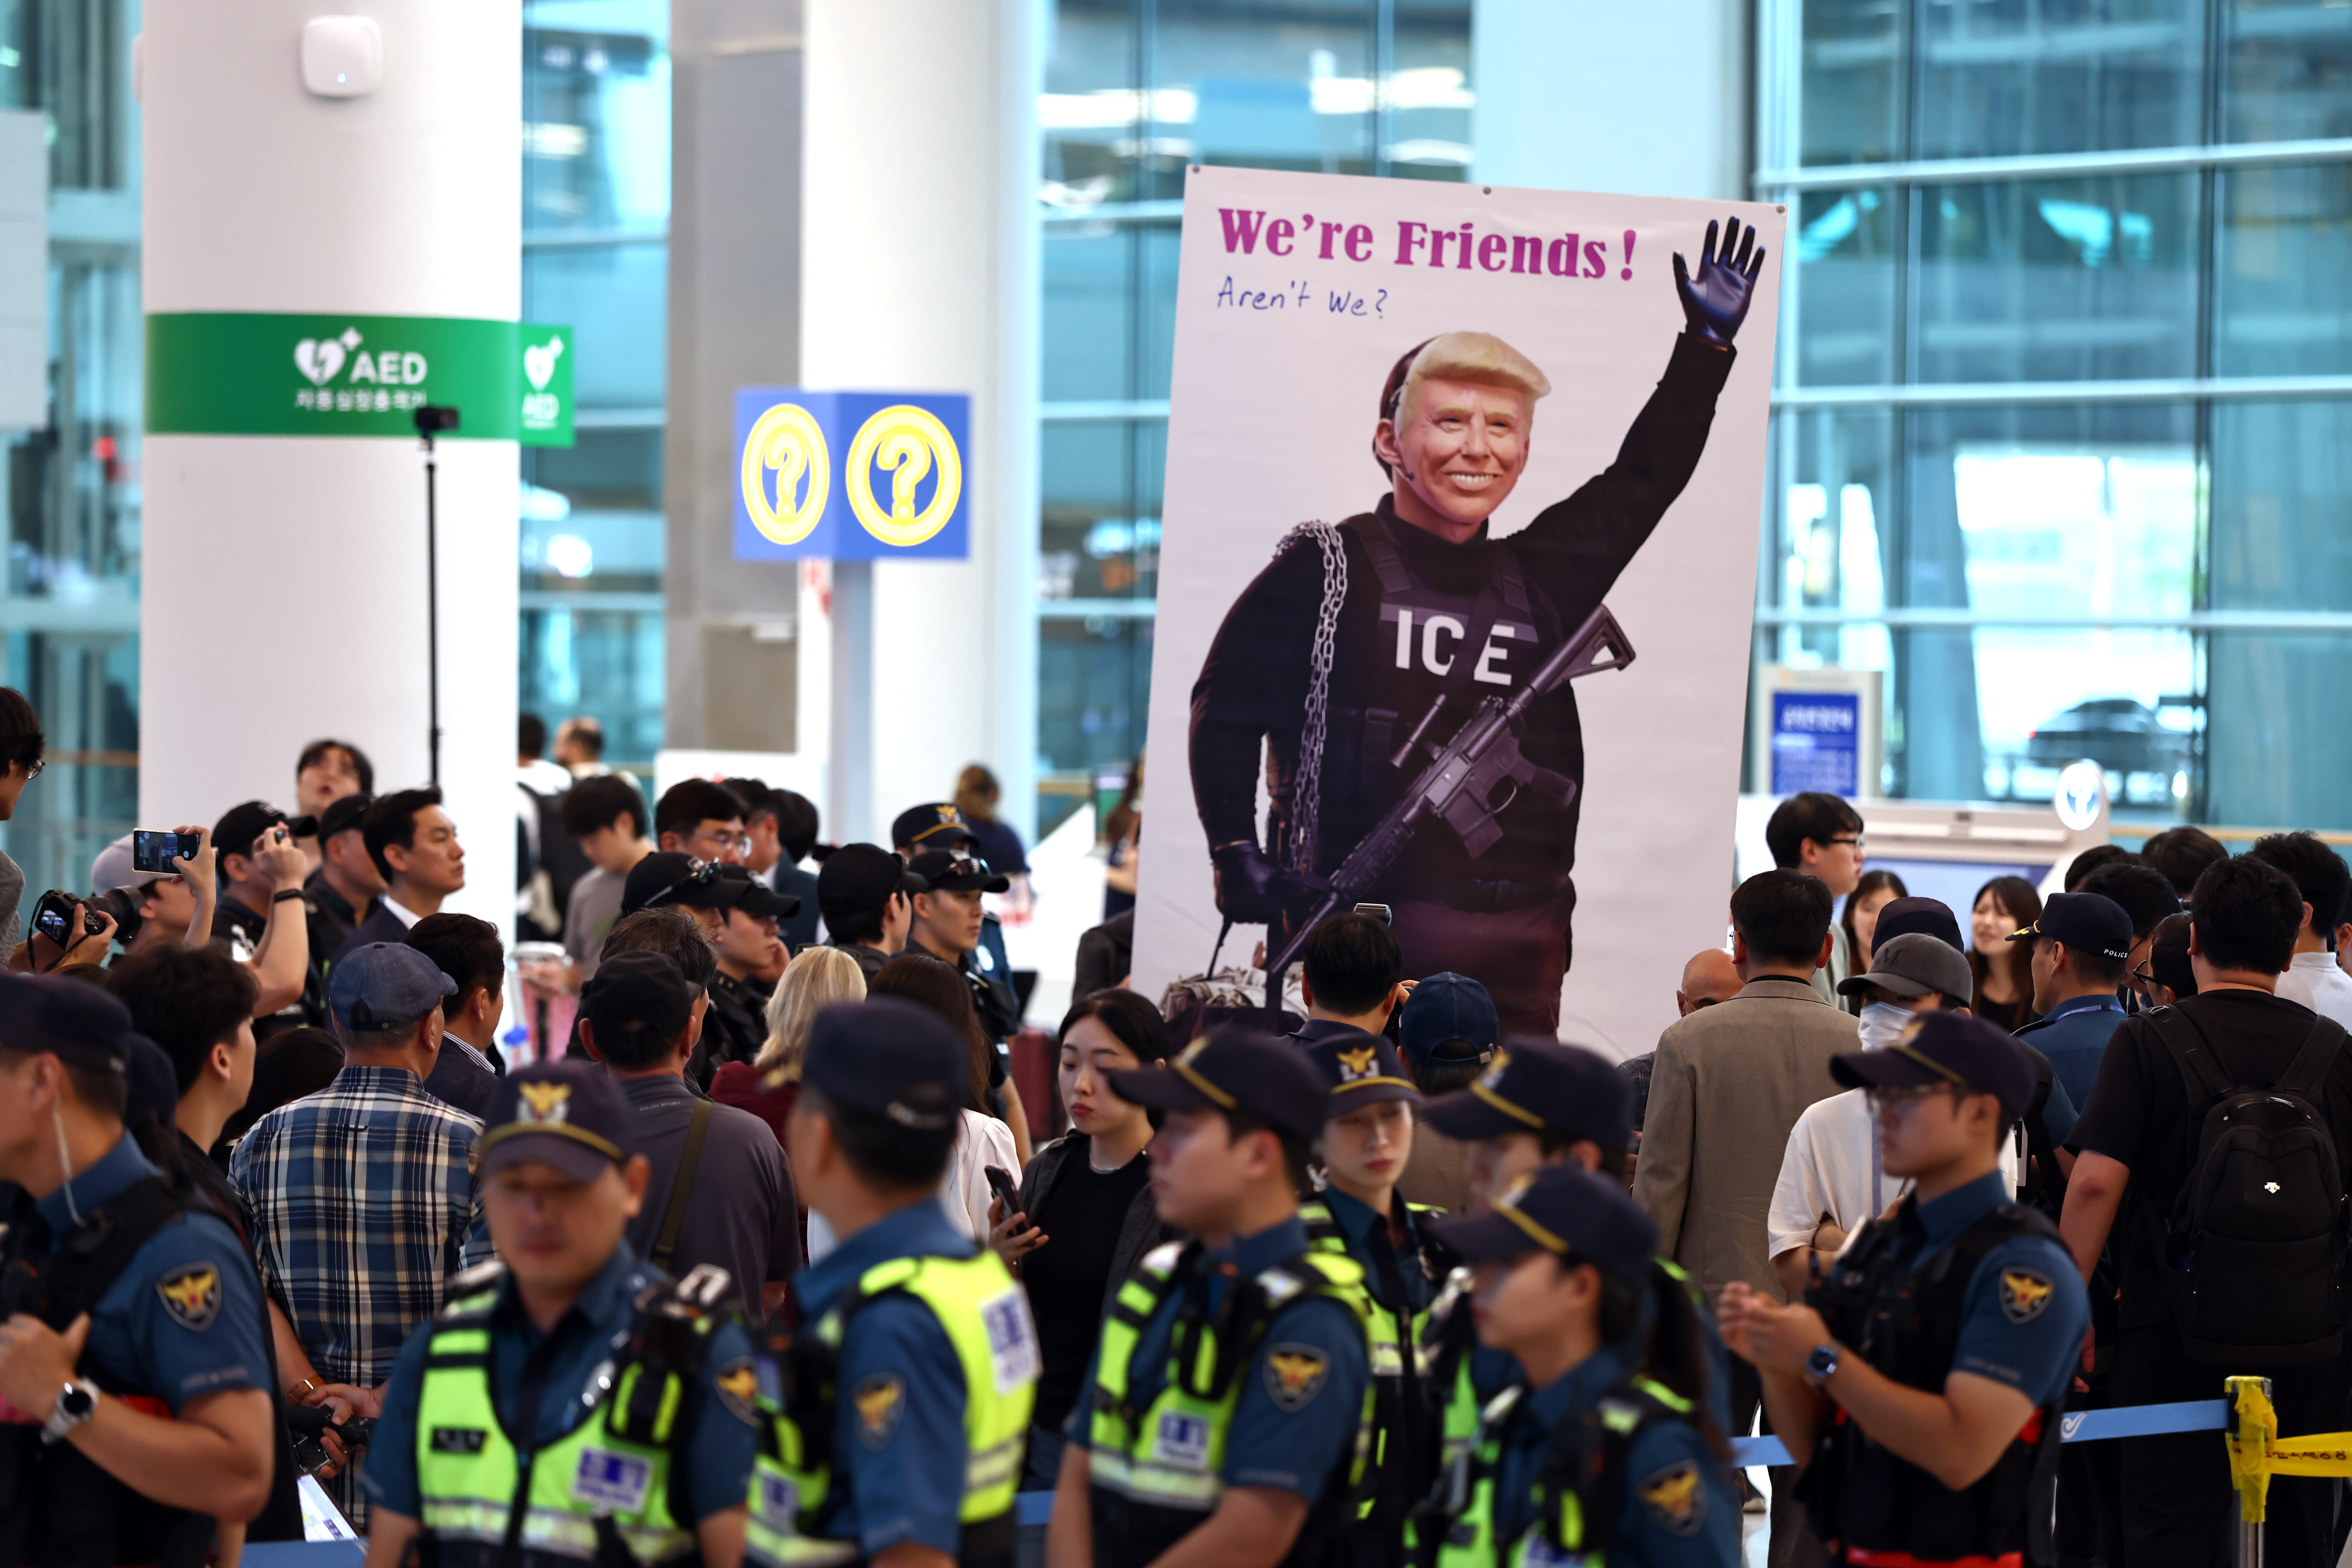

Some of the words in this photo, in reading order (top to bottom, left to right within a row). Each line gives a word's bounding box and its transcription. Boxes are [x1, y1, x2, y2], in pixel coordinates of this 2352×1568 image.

[1218, 208, 1374, 262] We're
[1217, 275, 1311, 310] Aren't
[1329, 288, 1388, 319] We?
[349, 350, 428, 385] AED
[1395, 608, 1515, 686] ICE
[2104, 948, 2128, 958] POLICE
